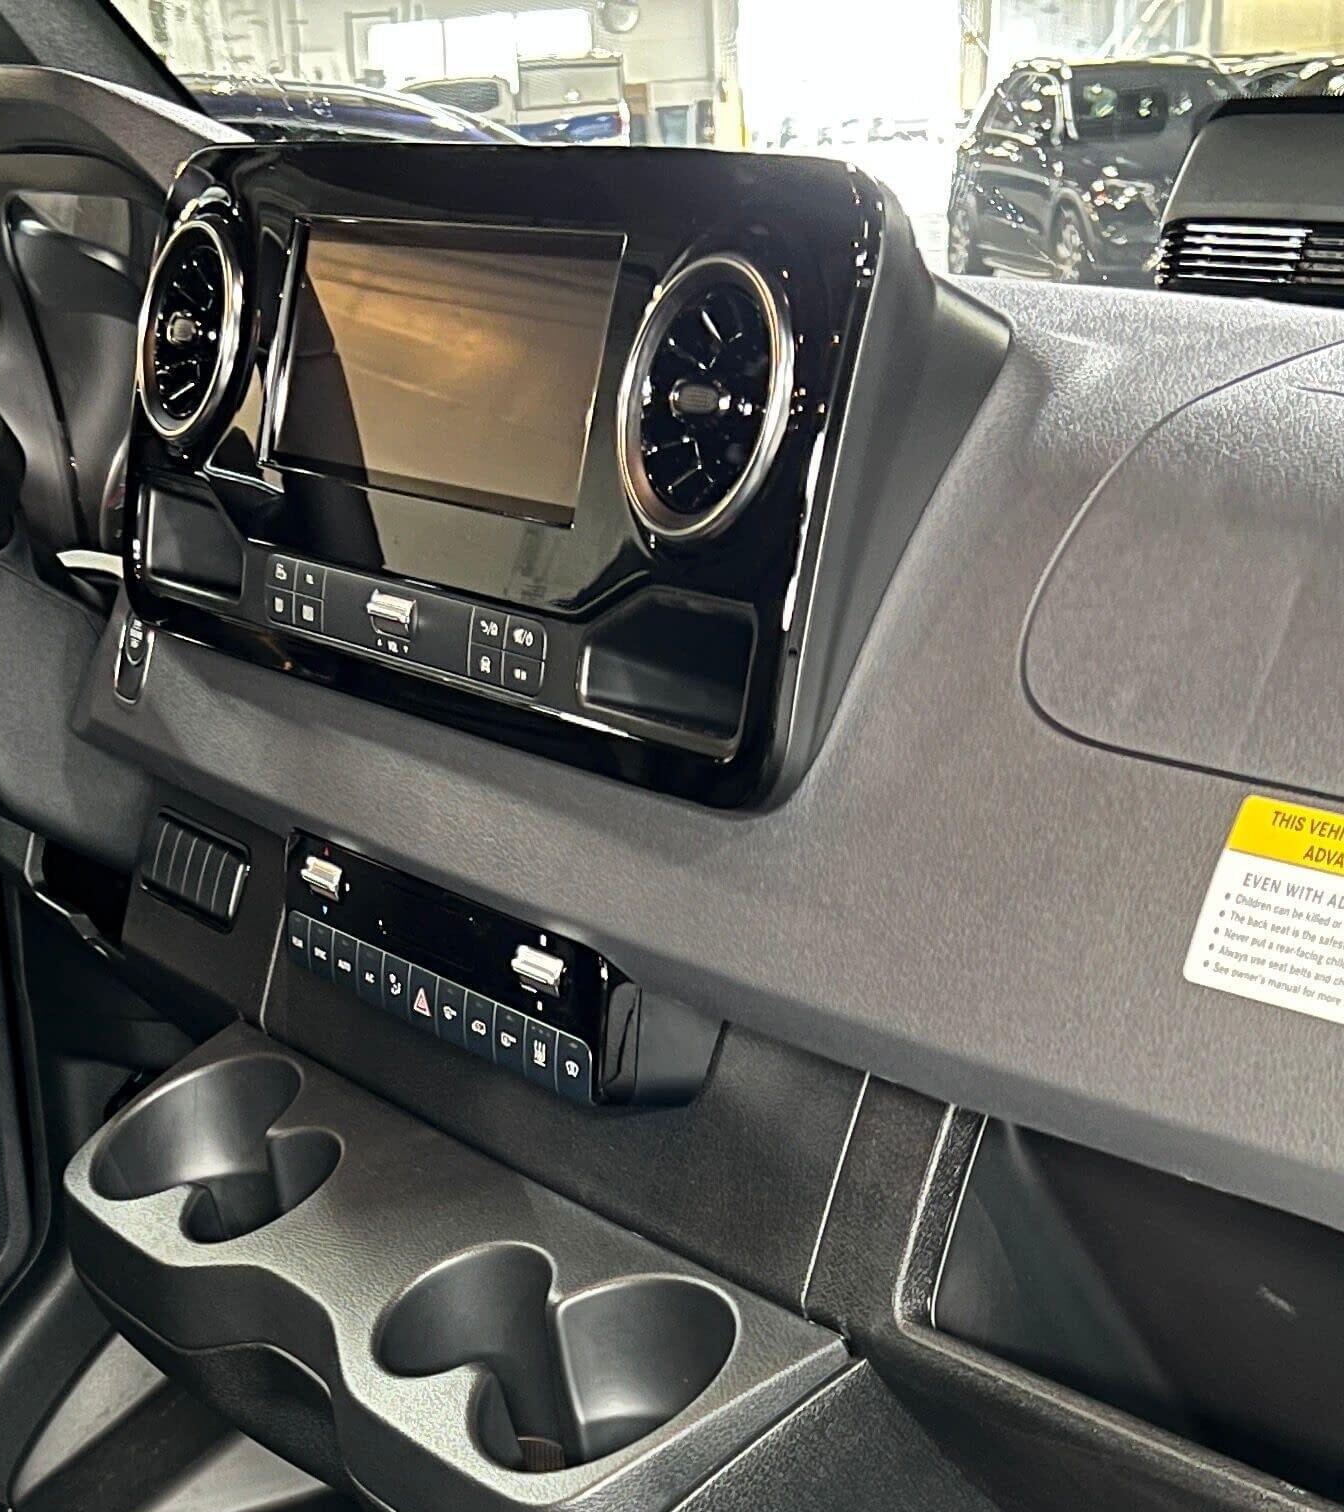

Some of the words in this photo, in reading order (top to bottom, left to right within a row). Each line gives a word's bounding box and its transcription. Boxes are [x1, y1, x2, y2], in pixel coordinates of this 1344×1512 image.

[1271, 810, 1306, 832] THIS
[1242, 872, 1282, 893] EVEN
[1286, 882, 1325, 904] WITH
[1230, 910, 1246, 924] The
[1247, 915, 1268, 930] back
[1270, 923, 1291, 936] seat
[1292, 926, 1300, 938] is
[1302, 930, 1317, 943] the
[1235, 893, 1272, 912] Children
[1273, 905, 1290, 916] can
[1292, 907, 1304, 920] be
[1332, 919, 1343, 929] or
[1224, 927, 1250, 943] Never
[1251, 937, 1267, 948] put
[1268, 942, 1274, 950] a
[1219, 944, 1249, 962] Always
[1250, 955, 1267, 966] use
[1268, 960, 1289, 973] seat
[1289, 964, 1312, 979] belts
[1314, 972, 1332, 984] and
[1213, 961, 1230, 975] See
[1268, 978, 1301, 994] manual
[1302, 985, 1316, 998] for
[1317, 992, 1342, 1006] more
